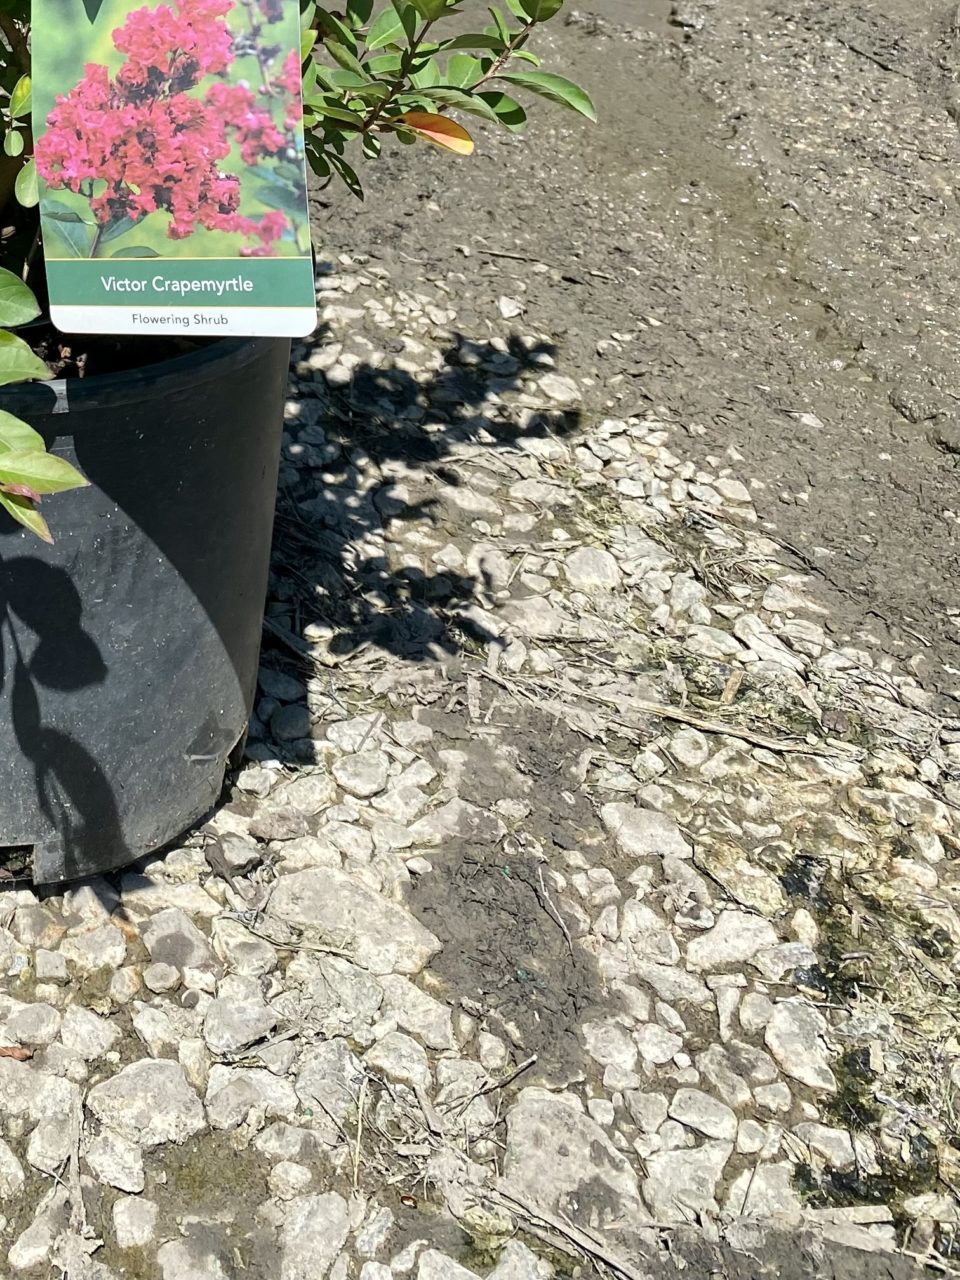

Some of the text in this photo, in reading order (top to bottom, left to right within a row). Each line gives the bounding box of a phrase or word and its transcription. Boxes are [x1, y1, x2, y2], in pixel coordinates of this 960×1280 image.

[100, 274, 254, 297] Victor Crapemyrtle
[131, 312, 229, 328] Flowering Shrub
